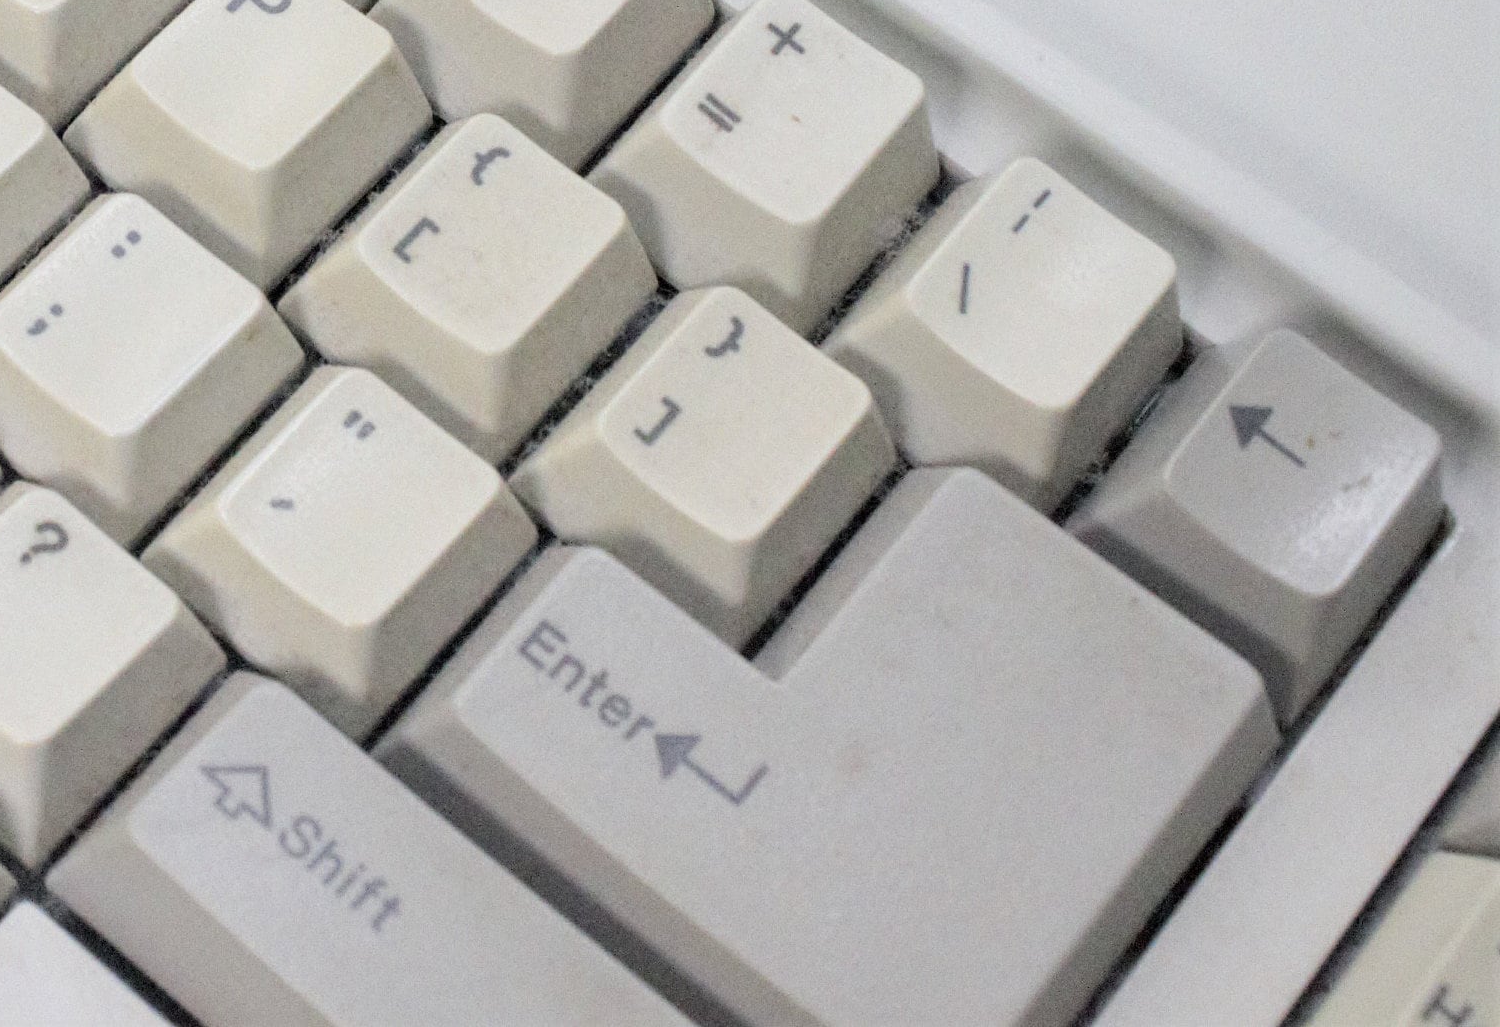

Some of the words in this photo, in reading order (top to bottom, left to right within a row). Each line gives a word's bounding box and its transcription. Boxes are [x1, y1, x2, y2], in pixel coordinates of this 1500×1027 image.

[767, 23, 805, 55] +
[698, 93, 741, 132] =
[471, 147, 510, 186] {
[112, 231, 141, 258] :
[393, 217, 440, 263] [
[29, 305, 62, 335] ;
[705, 317, 744, 358] }
[634, 397, 681, 445] ]
[20, 521, 68, 564] ?
[516, 618, 654, 742] Enter
[278, 814, 401, 935] Shift
